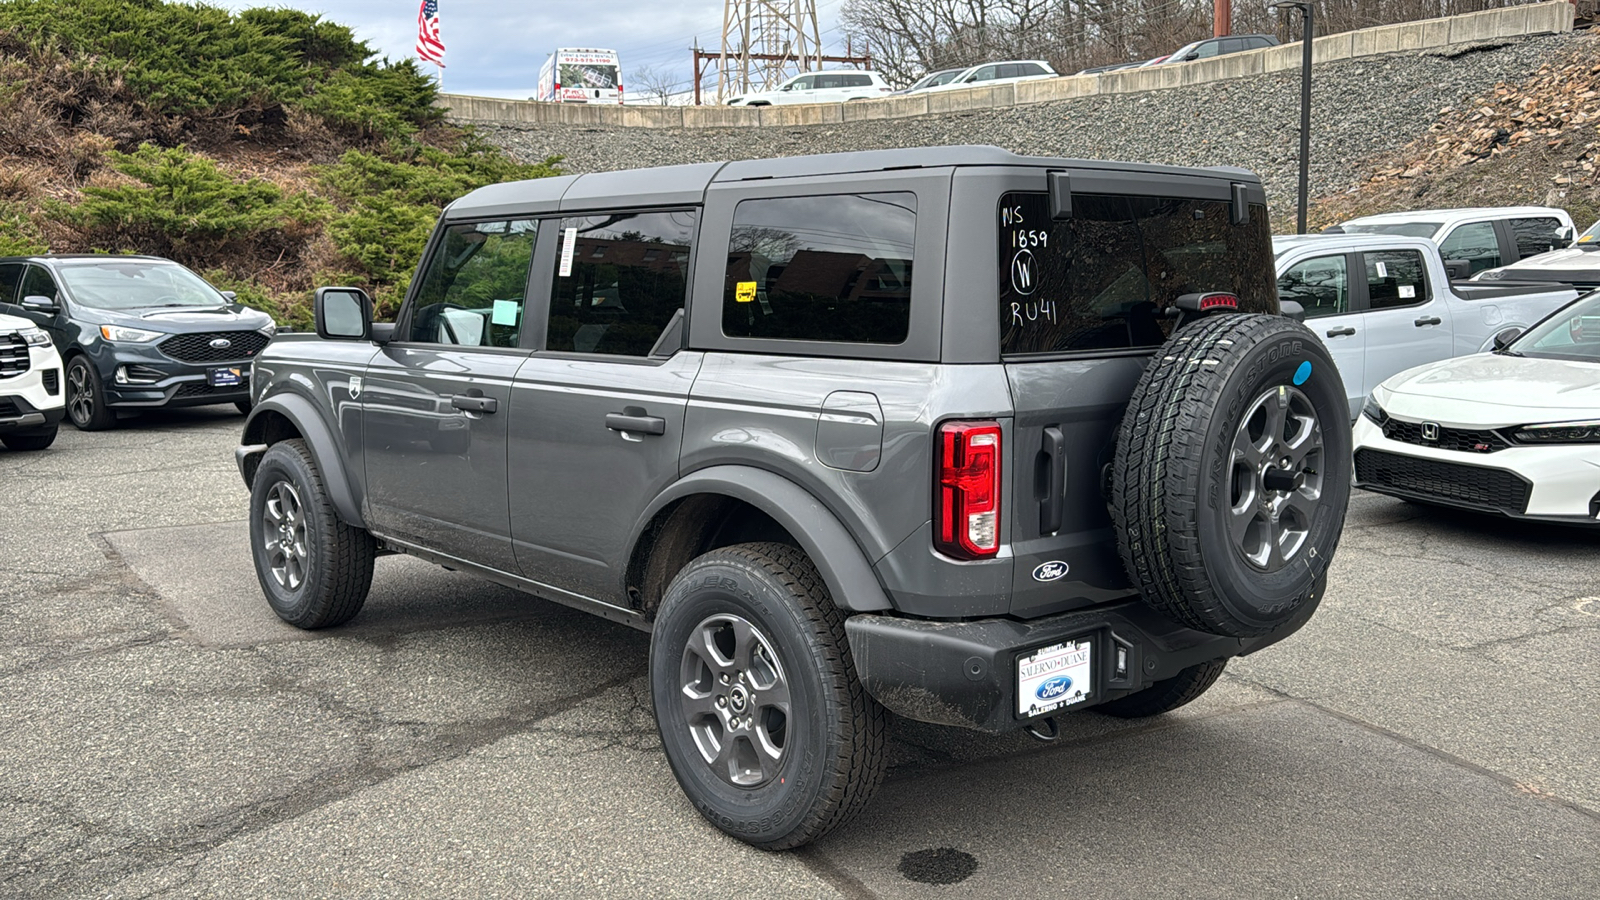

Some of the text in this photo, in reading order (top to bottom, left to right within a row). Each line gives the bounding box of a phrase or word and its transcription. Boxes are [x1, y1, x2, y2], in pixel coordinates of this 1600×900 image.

[1002, 205, 1024, 228] NS
[1012, 229, 1048, 248] 1859
[1039, 563, 1063, 579] Ford
[1020, 650, 1088, 679] SALERNO DUANE
[1042, 679, 1067, 698] Ford
[1027, 703, 1058, 718] SALERNO
